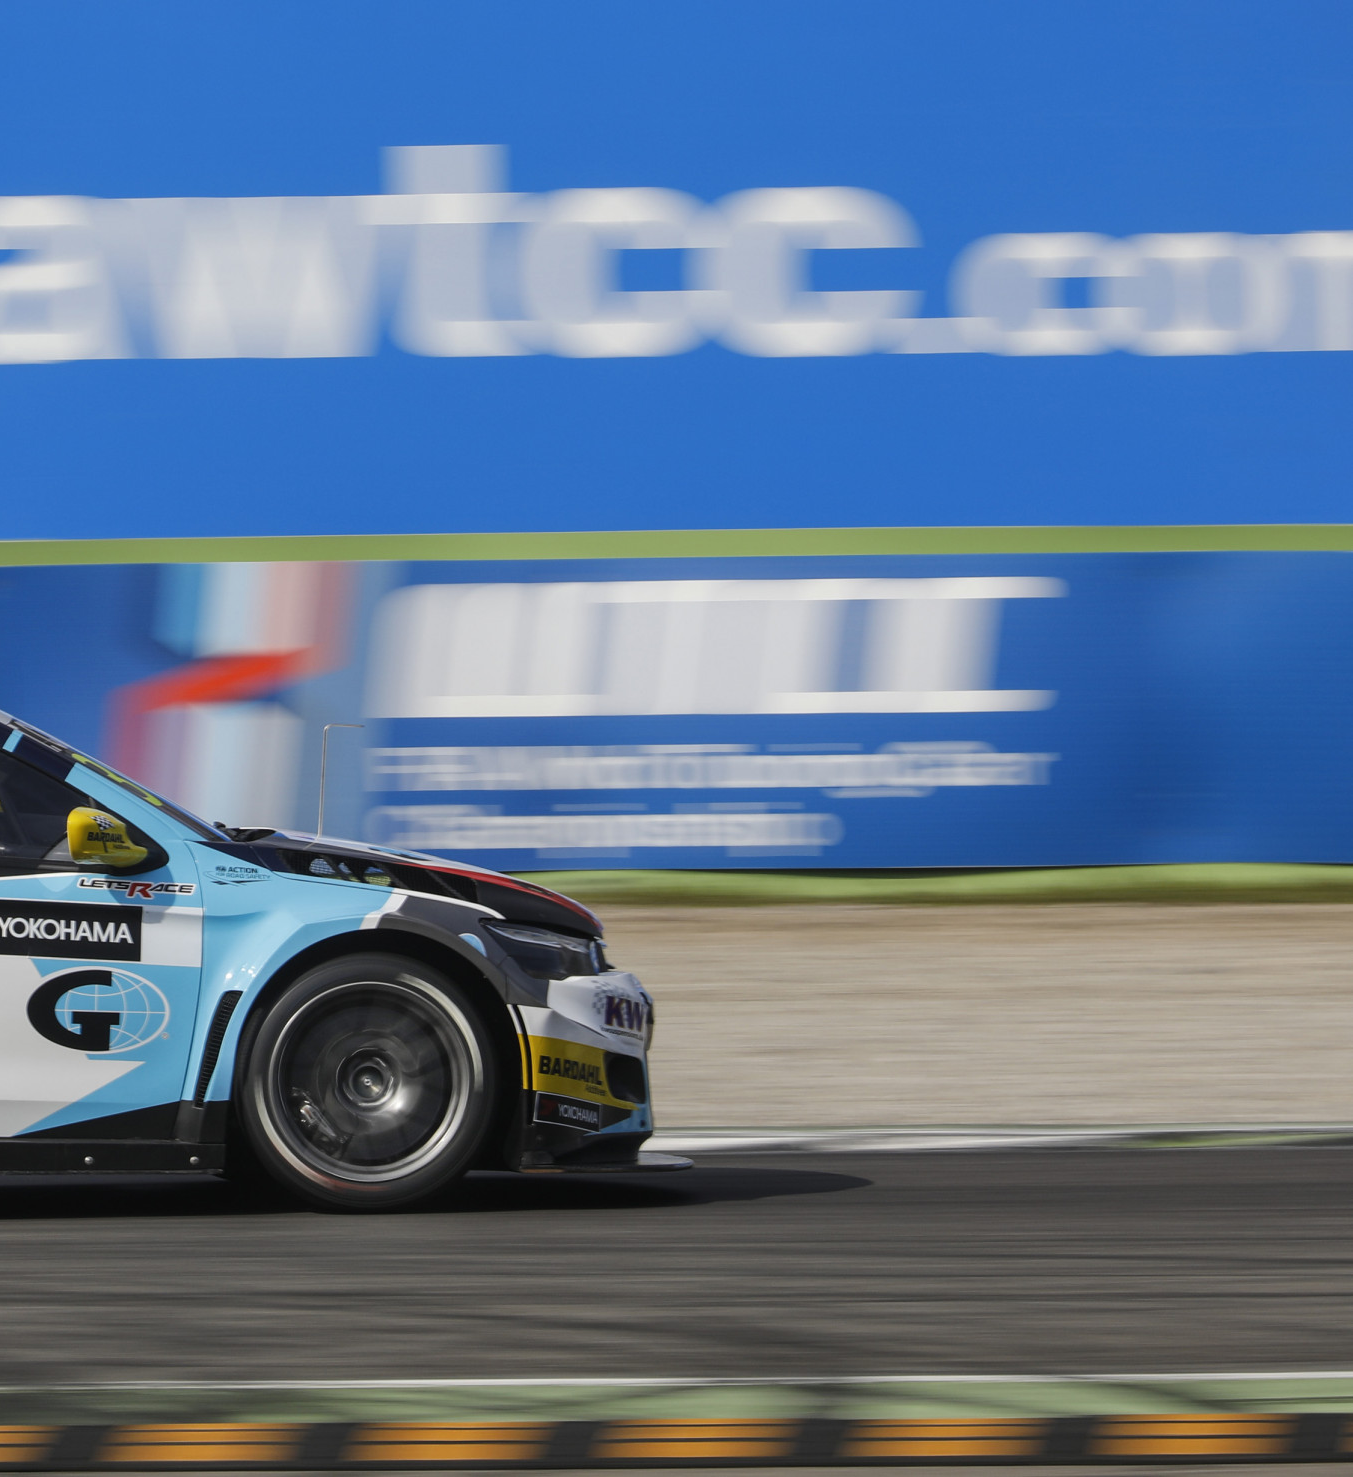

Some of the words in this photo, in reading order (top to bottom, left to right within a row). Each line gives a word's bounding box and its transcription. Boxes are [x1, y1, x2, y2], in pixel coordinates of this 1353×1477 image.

[228, 866, 259, 874] ACTION
[79, 878, 195, 899] LETSRACE
[538, 1054, 604, 1086] BARDAHL
